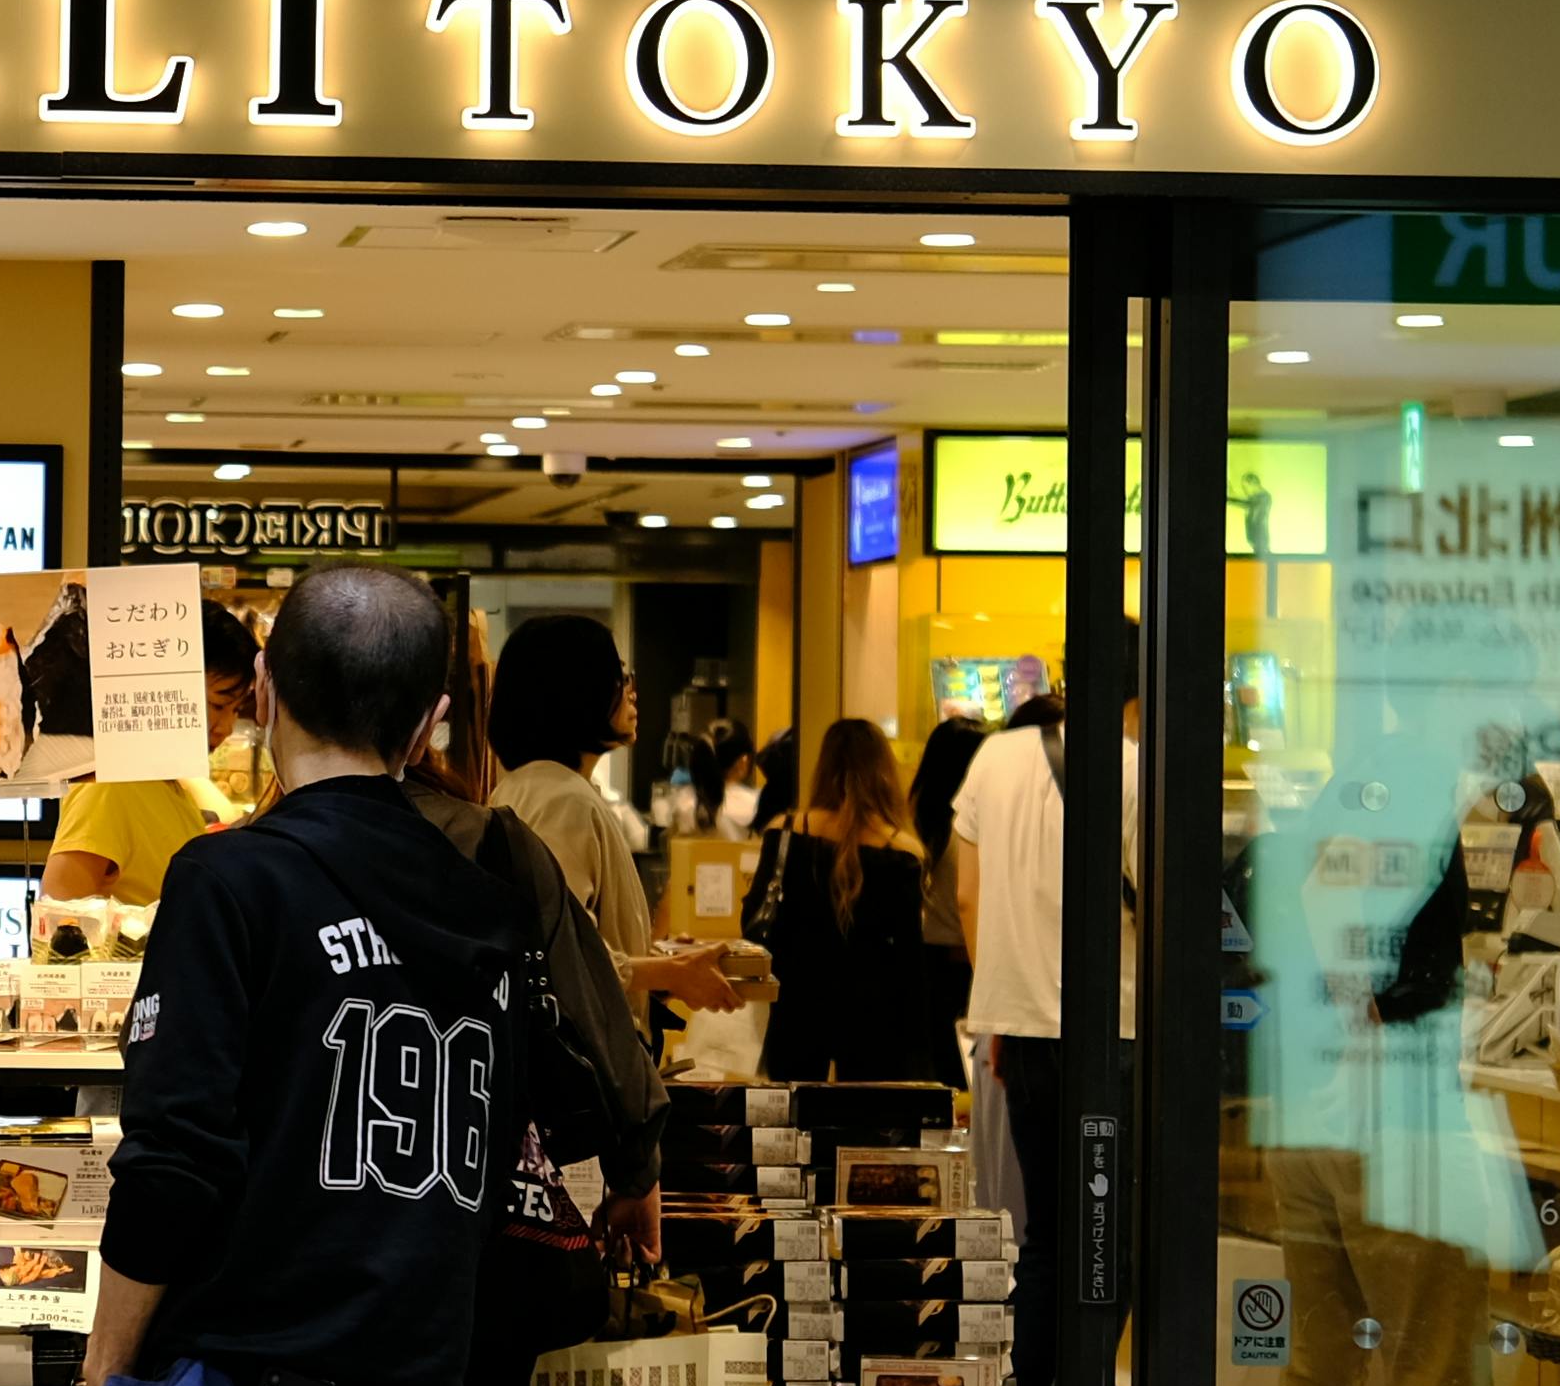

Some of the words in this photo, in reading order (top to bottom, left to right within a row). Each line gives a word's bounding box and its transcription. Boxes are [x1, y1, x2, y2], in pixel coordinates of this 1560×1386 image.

[106, 601, 187, 623] こだわり
[106, 637, 189, 659] おにぎり
[1227, 1002, 1244, 1019] 動
[1084, 1122, 1115, 1137] 自動
[1092, 1144, 1105, 1169] 手を
[1092, 1202, 1105, 1300] 近づけてください
[1234, 1336, 1286, 1348] ドアに注意
[1241, 1352, 1279, 1360] CAUTION
